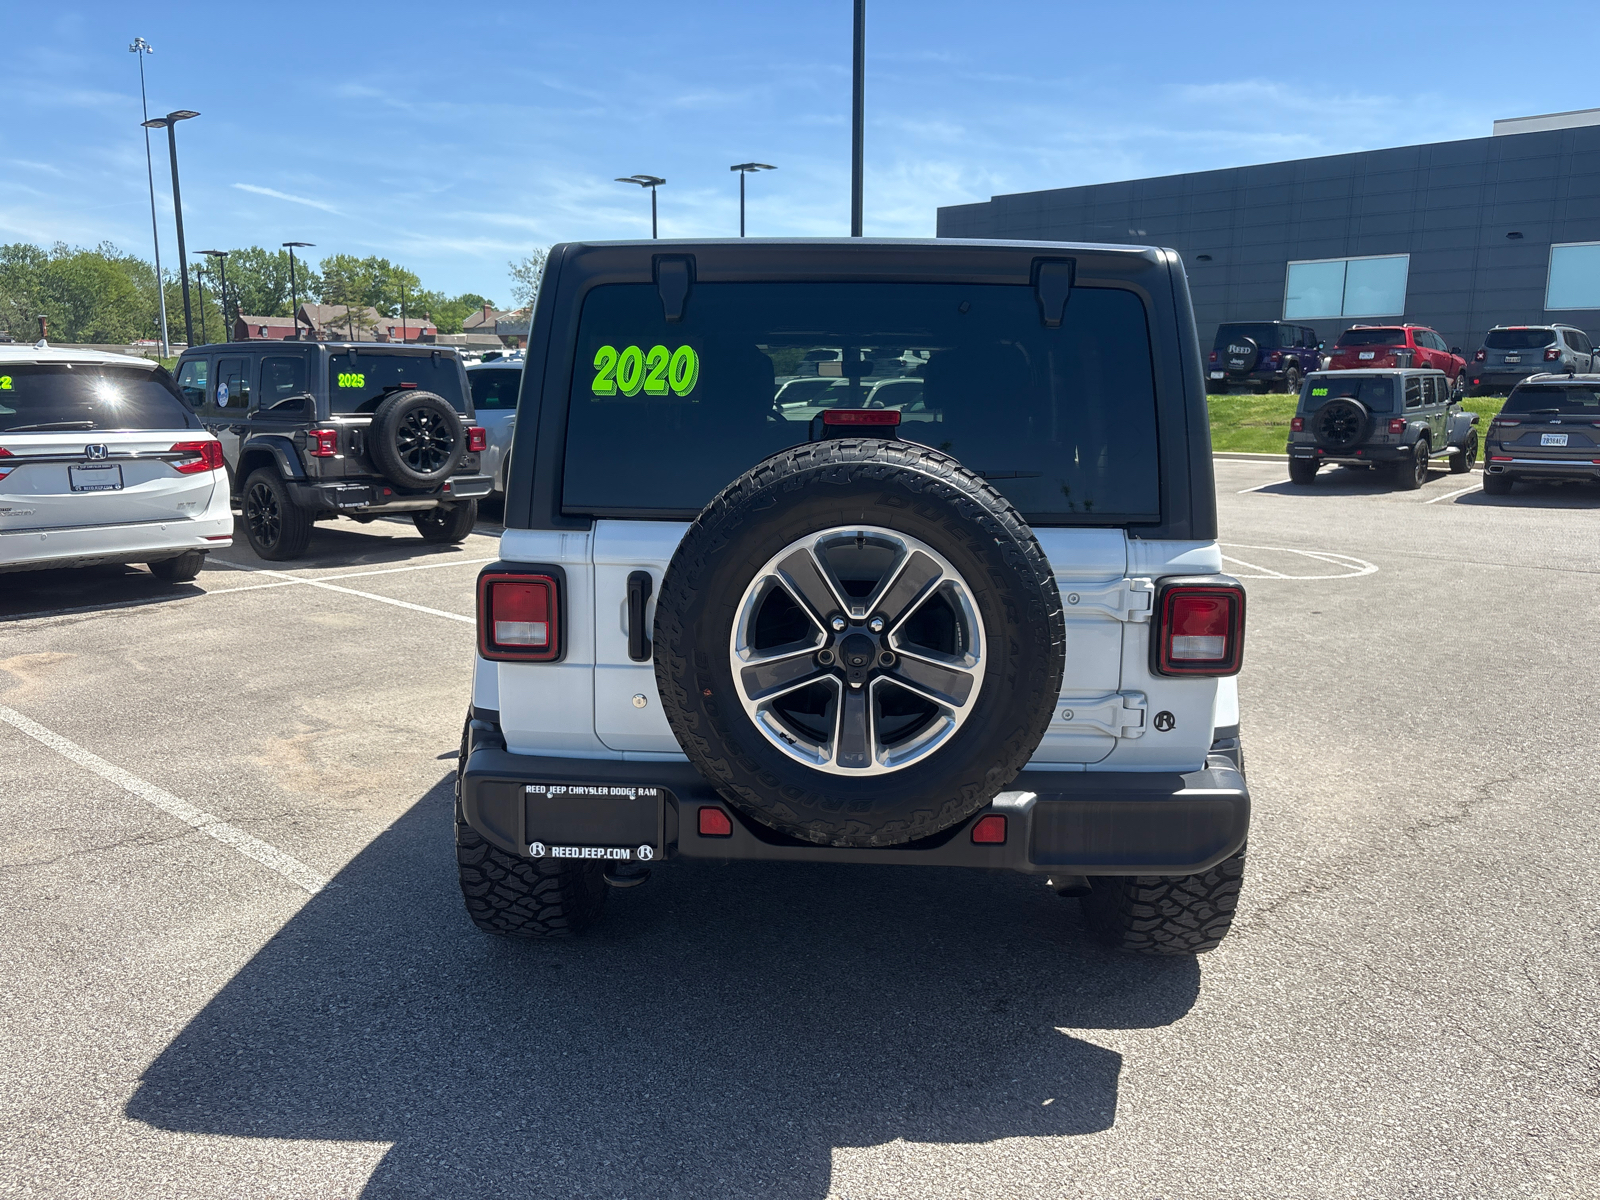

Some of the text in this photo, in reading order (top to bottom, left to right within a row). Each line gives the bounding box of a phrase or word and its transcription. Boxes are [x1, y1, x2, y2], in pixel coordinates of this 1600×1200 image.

[1228, 344, 1251, 354] REED
[592, 345, 699, 397] 2020
[338, 373, 365, 388] 2025
[526, 785, 657, 796] REED JEEP CHRYSLER DODGE RAM
[552, 846, 630, 860] REEDJEEP.COM
